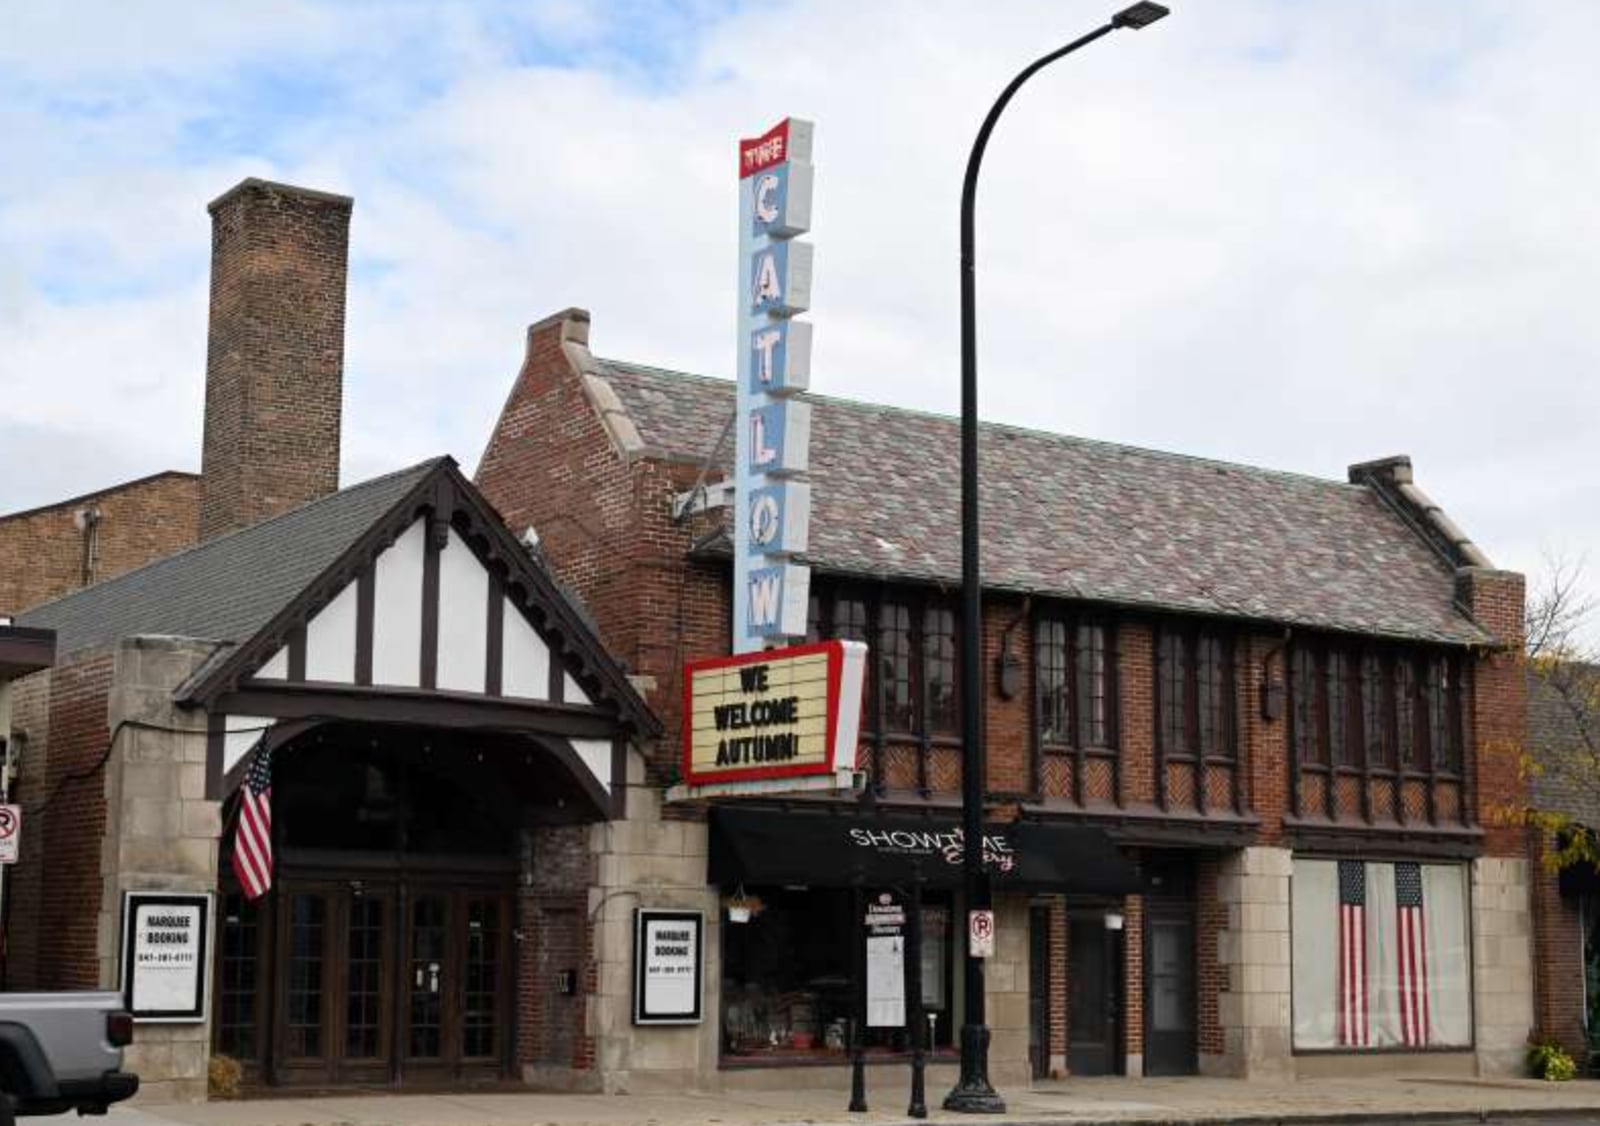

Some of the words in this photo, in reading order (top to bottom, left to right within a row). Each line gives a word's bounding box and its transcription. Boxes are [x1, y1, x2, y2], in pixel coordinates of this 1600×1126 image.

[744, 136, 782, 168] THE
[748, 173, 781, 626] CATLOW
[740, 664, 769, 693] WE
[714, 696, 799, 731] WELCOME
[715, 732, 799, 766] AUTUMN!
[147, 915, 191, 928] MARQUEE
[147, 932, 188, 944] BOOKING
